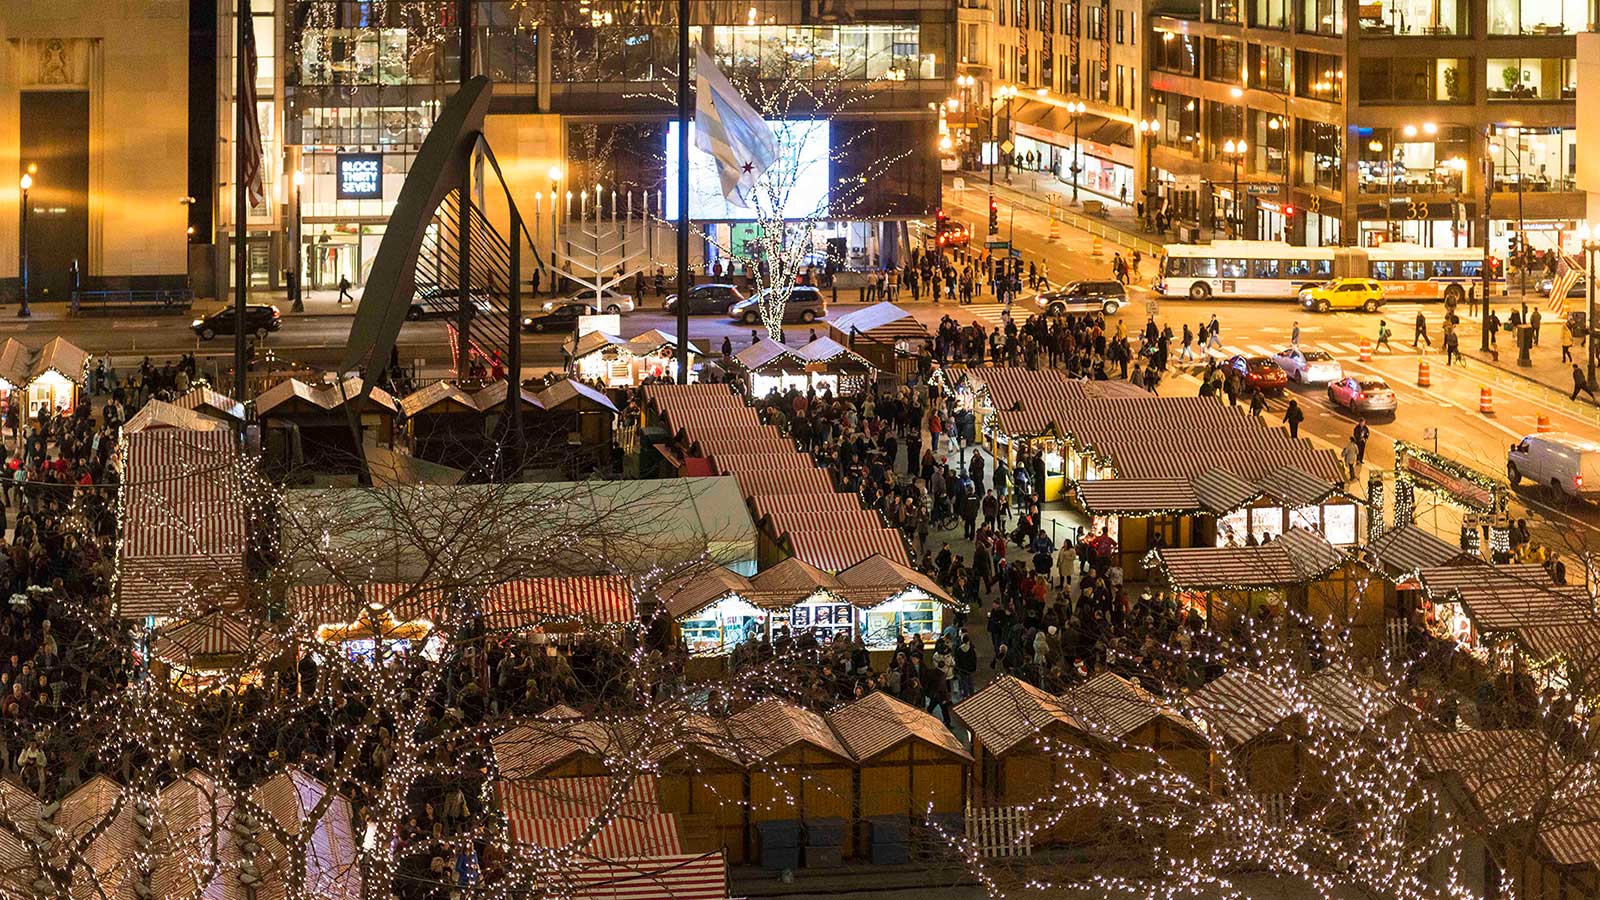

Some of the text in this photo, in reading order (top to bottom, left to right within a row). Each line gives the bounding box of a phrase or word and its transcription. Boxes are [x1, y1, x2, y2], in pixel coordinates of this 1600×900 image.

[1070, 2, 1079, 65] Walgreens
[1100, 4, 1109, 73] Walgreens
[342, 161, 378, 172] BLOCK
[342, 172, 378, 182] THIRTY
[342, 182, 377, 192] SEVEN
[1309, 193, 1320, 212] 33
[1406, 201, 1429, 220] 33
